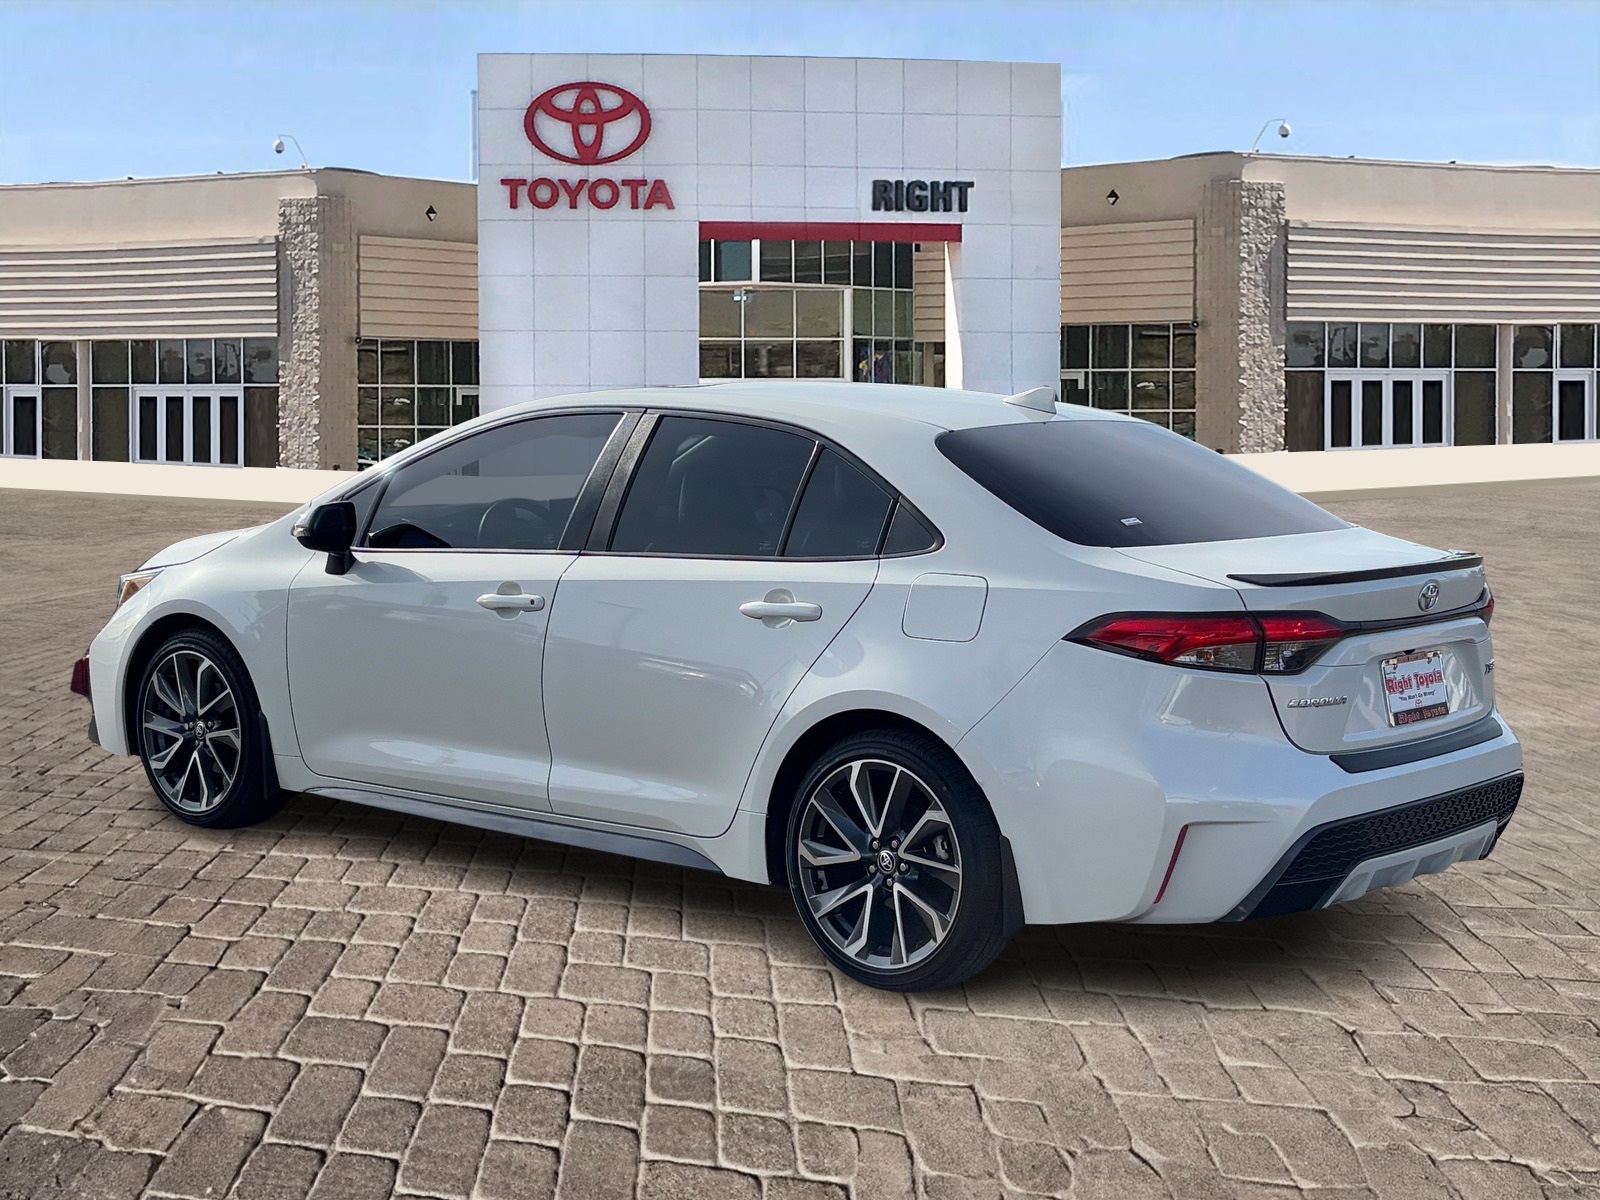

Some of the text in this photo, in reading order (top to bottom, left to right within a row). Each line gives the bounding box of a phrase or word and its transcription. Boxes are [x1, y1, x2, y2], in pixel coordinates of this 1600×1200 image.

[500, 177, 675, 210] TOYOTA
[872, 179, 975, 212] RIGHT
[1386, 669, 1443, 695] Right Toyota
